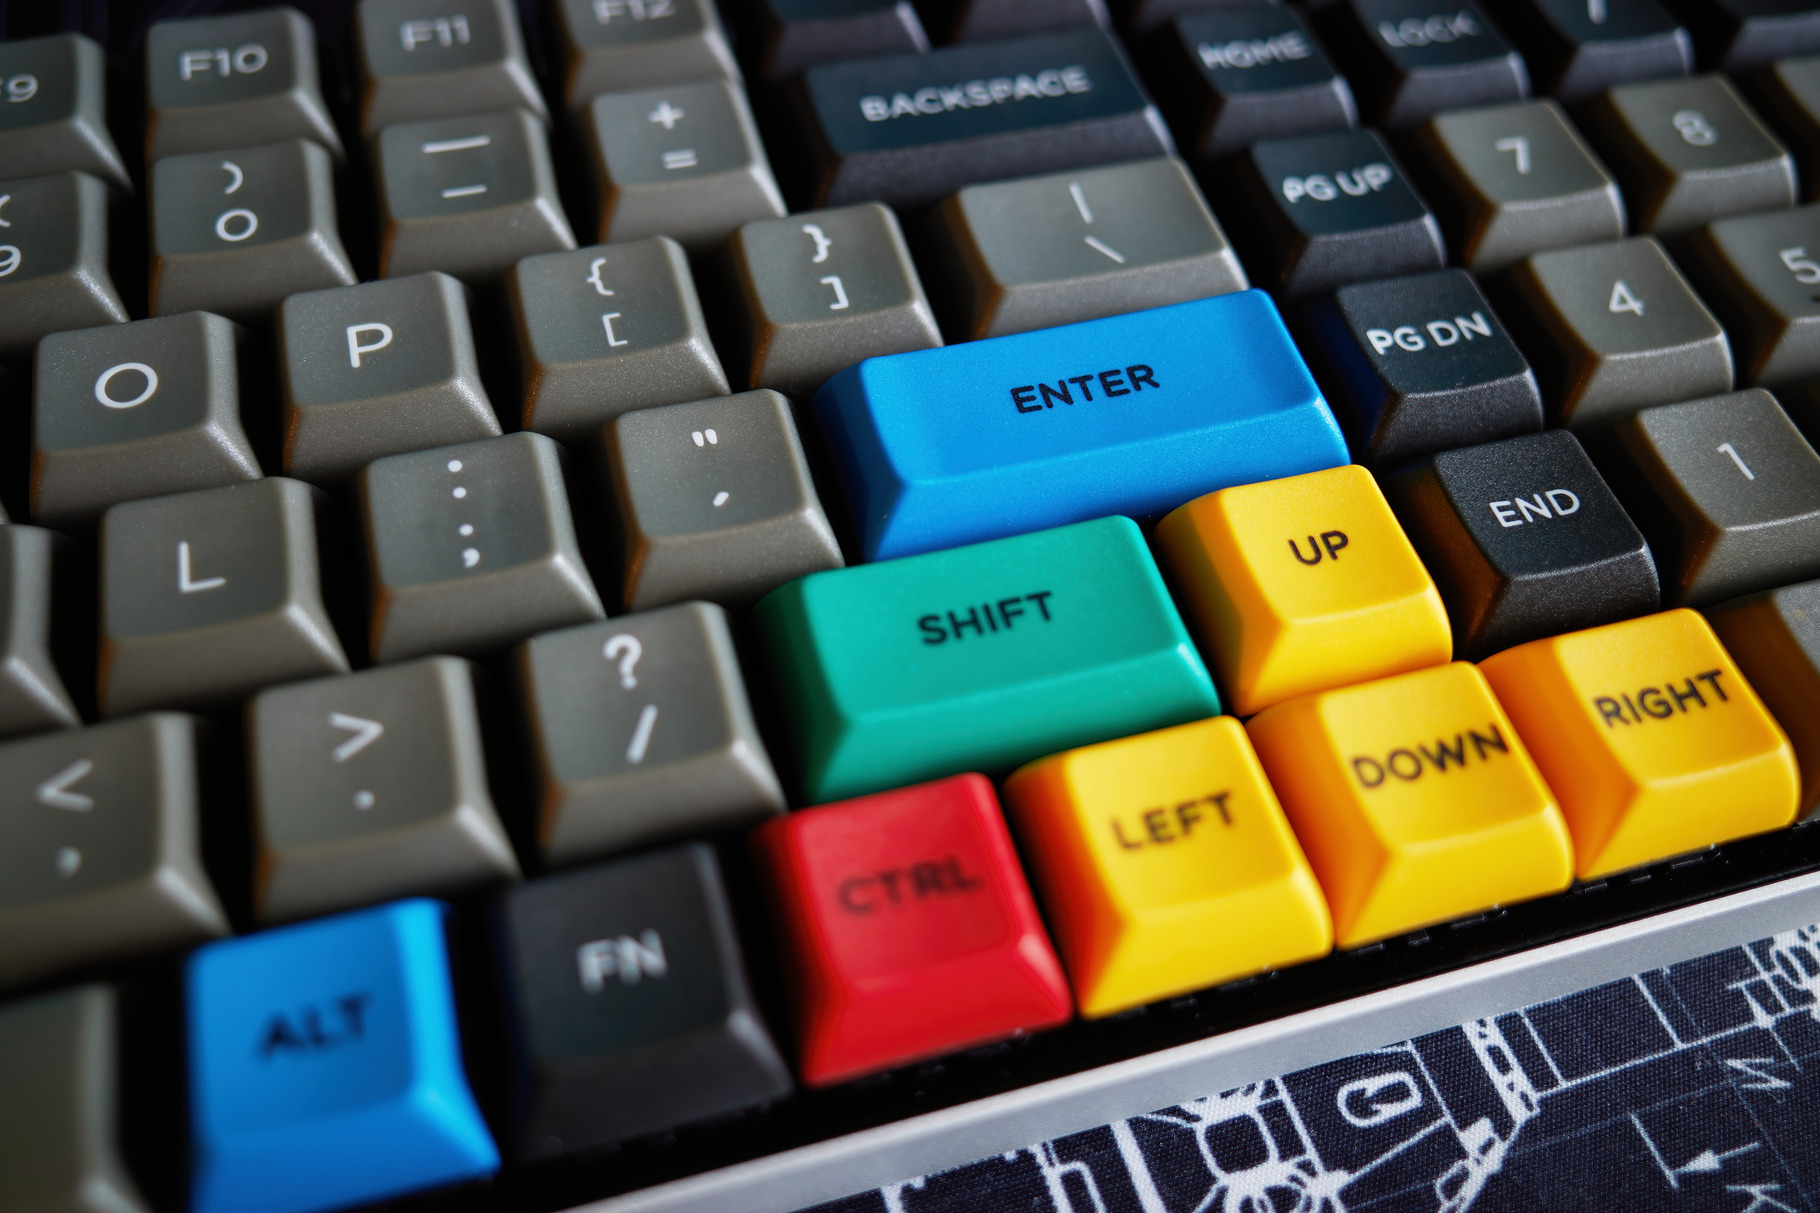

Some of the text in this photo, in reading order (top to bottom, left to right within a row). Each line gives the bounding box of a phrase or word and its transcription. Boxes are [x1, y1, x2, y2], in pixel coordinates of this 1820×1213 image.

[402, 15, 471, 51] F11
[1199, 32, 1310, 69] HOME
[180, 44, 268, 80] F10
[0, 74, 38, 102] 9
[860, 66, 1092, 122] BACKSPACE
[648, 101, 684, 129] +
[1673, 110, 1717, 146] 8
[662, 148, 698, 169] =
[1497, 136, 1530, 174] 7
[223, 163, 243, 194] )
[1283, 162, 1391, 203] PG UP
[804, 225, 830, 262] }
[587, 258, 613, 295] {
[1781, 248, 1820, 283] 5
[821, 276, 849, 309] ]
[1610, 282, 1643, 314] 4
[347, 323, 393, 368] P
[602, 313, 627, 347] [
[1367, 313, 1491, 354] PG DN
[95, 363, 158, 409] O
[1010, 364, 1159, 414] ENTER
[448, 460, 466, 498] :
[1718, 443, 1754, 480] 1
[1490, 489, 1580, 528] END
[460, 525, 479, 567] ;
[1288, 530, 1348, 566] UP
[179, 542, 225, 592] L
[917, 591, 1051, 646] SHIFT
[603, 633, 642, 689] ?
[1594, 669, 1729, 729] RIGHT
[329, 712, 384, 762] >
[626, 704, 658, 763] /
[1352, 725, 1509, 788] DOWN
[37, 759, 93, 812] <
[1113, 791, 1232, 851] LEFT
[838, 855, 984, 914] CTRL
[577, 930, 667, 992] FN
[258, 991, 371, 1060] ALT
